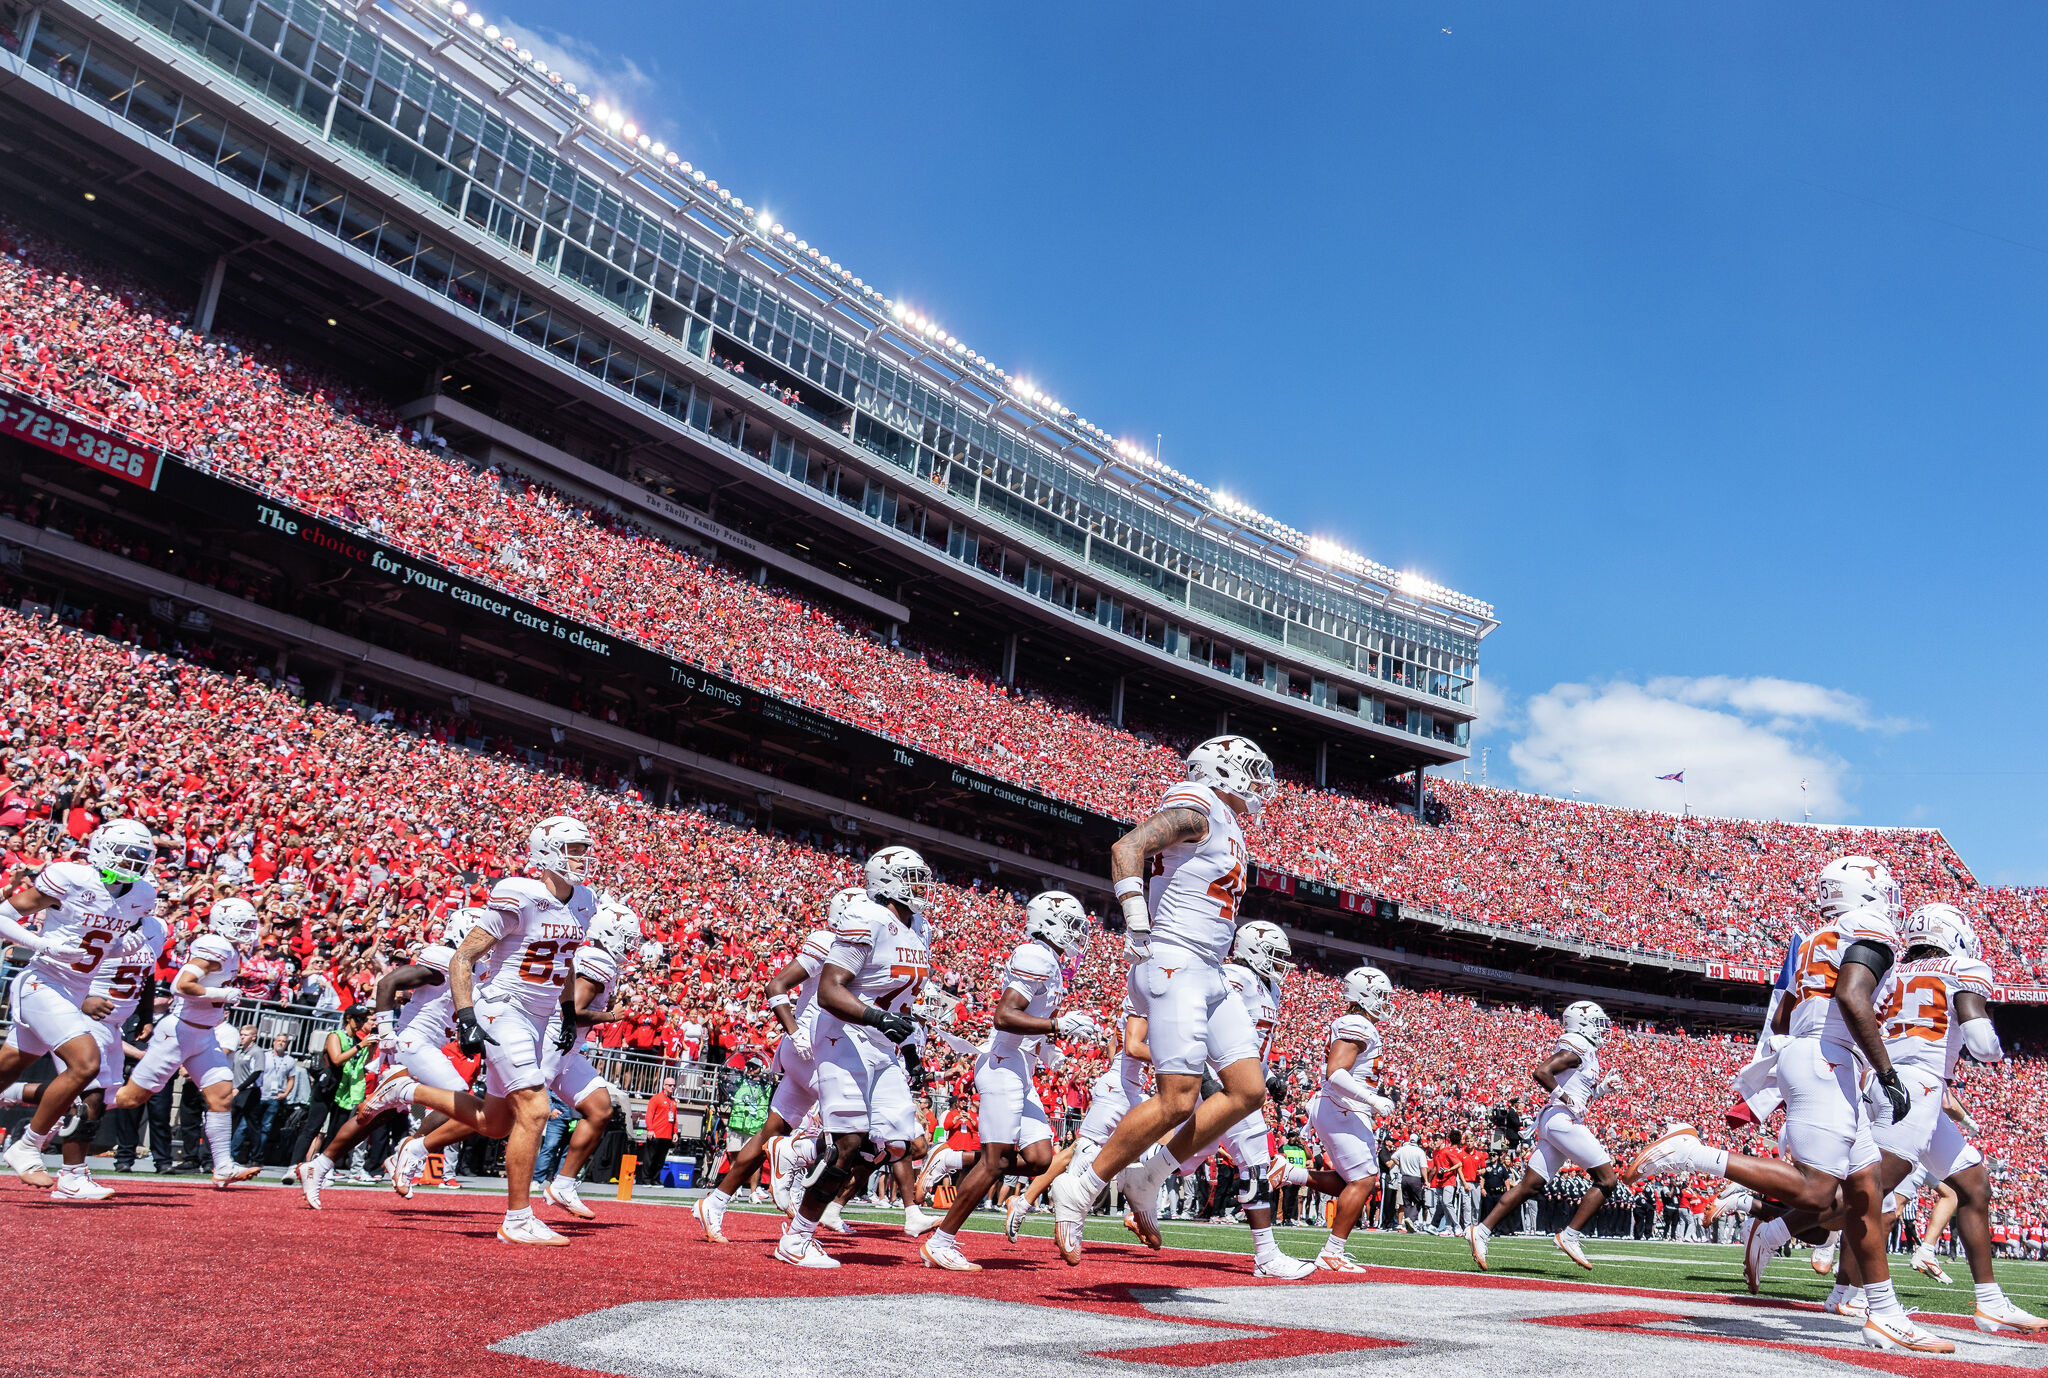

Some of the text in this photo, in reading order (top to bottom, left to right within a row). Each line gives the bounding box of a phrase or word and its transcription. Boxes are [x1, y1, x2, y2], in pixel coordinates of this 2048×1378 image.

[646, 495, 661, 508] The
[694, 516, 720, 536] Family
[257, 505, 611, 656] The choice for your cancer care is clear.
[670, 666, 742, 706] The James
[893, 749, 1083, 825] The for your cancer care is clear.
[1280, 876, 1287, 890] 0
[1349, 894, 1355, 908] 0
[82, 912, 131, 932] TEXAS
[541, 923, 583, 941] TEXAS
[519, 941, 580, 987] 83
[896, 946, 928, 965] TEXAS
[1710, 966, 1721, 977] 10
[1729, 967, 1759, 981] SMITH
[2008, 990, 2048, 1002] CASSADY
[942, 1186, 956, 1203] 10
